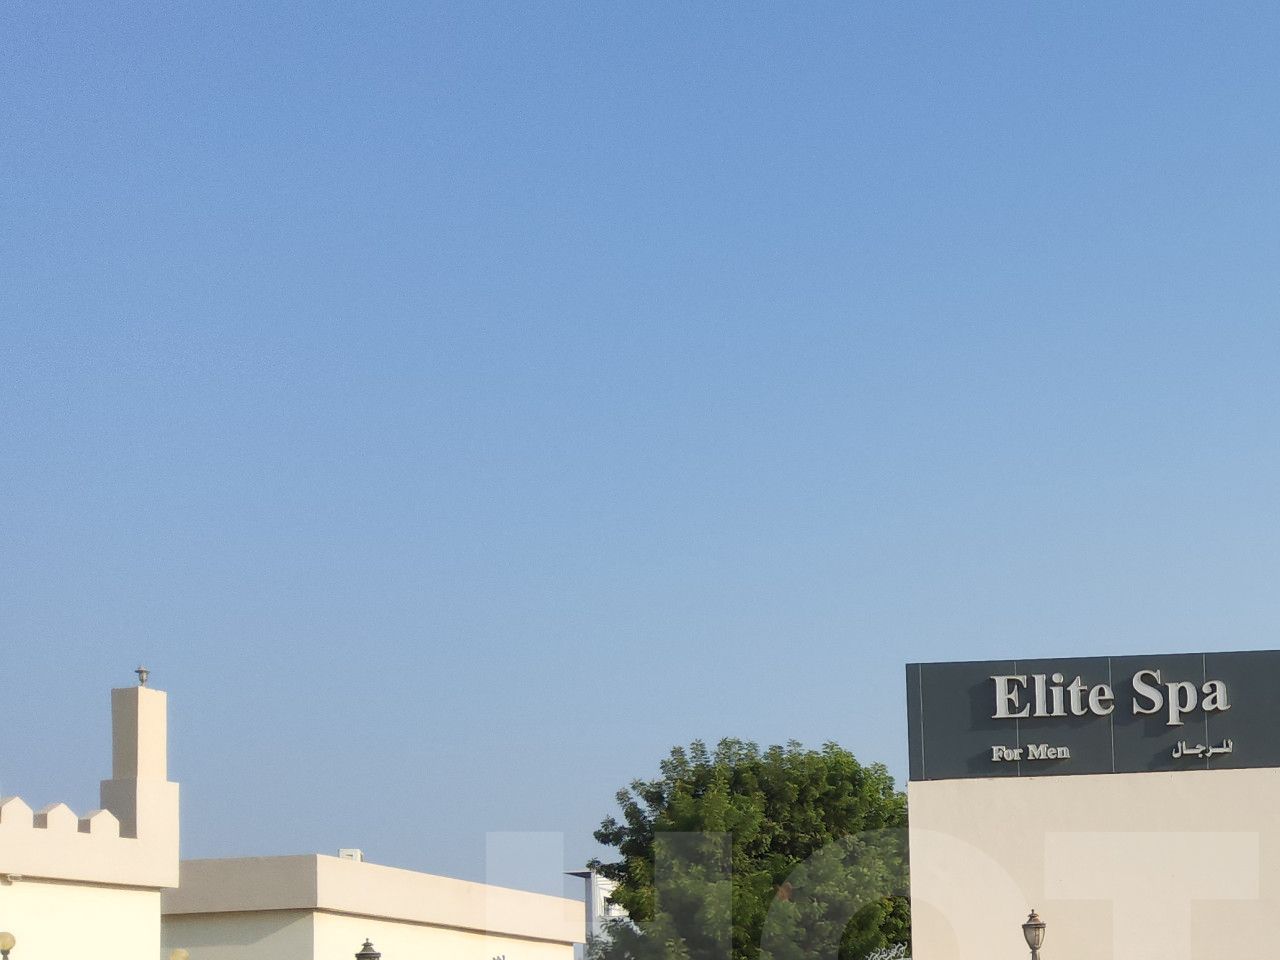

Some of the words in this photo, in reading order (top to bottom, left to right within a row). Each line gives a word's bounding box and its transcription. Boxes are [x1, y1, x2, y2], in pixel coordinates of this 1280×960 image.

[989, 672, 1115, 719] Elite
[1132, 669, 1231, 726] Spa
[991, 745, 1023, 762] For
[1027, 743, 1070, 760] Men
[1172, 739, 1233, 758] للرجال
